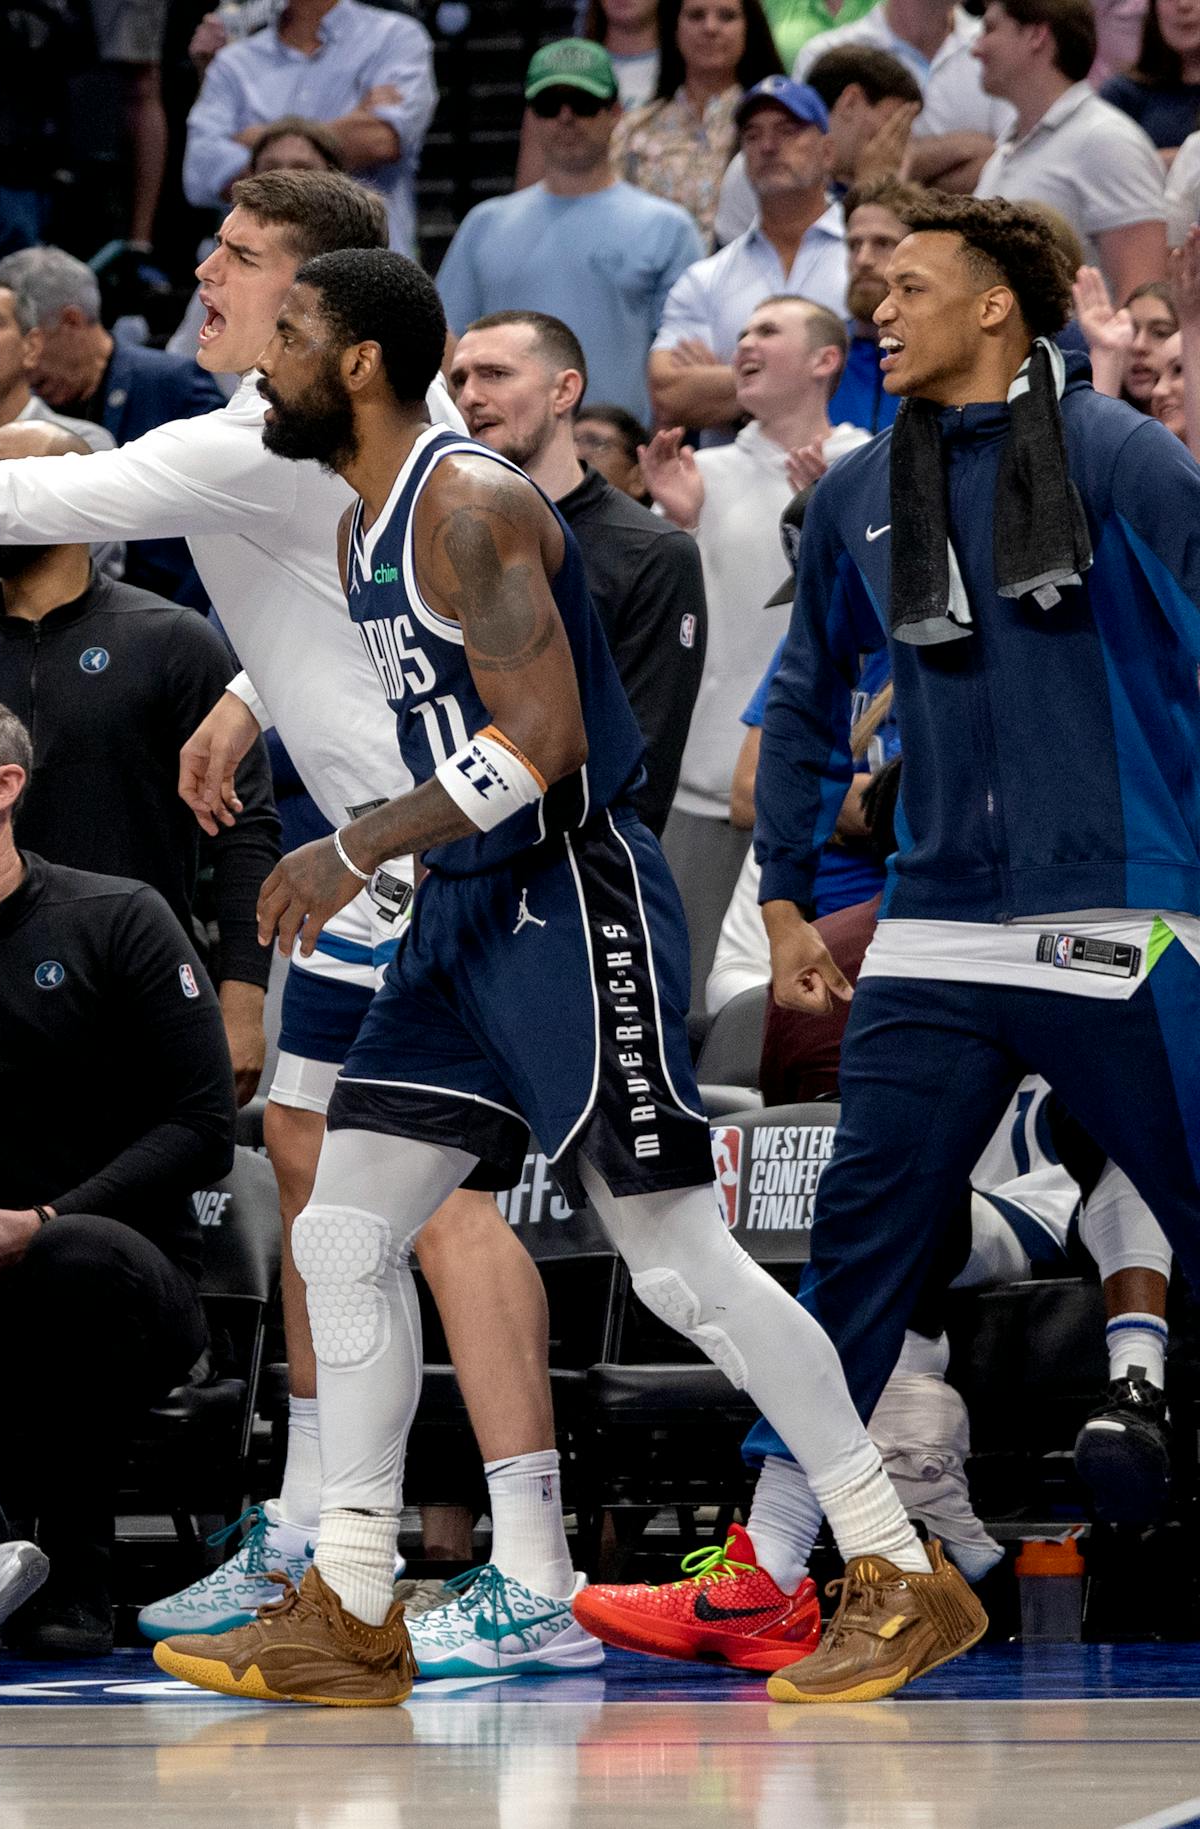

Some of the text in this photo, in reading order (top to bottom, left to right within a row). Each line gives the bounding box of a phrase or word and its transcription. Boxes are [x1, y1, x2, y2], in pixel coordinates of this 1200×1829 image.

[410, 694, 469, 768] 11
[602, 924, 661, 1159] MAVERICKS
[751, 1126, 836, 1160] WESTER
[748, 1160, 831, 1195] CONFE
